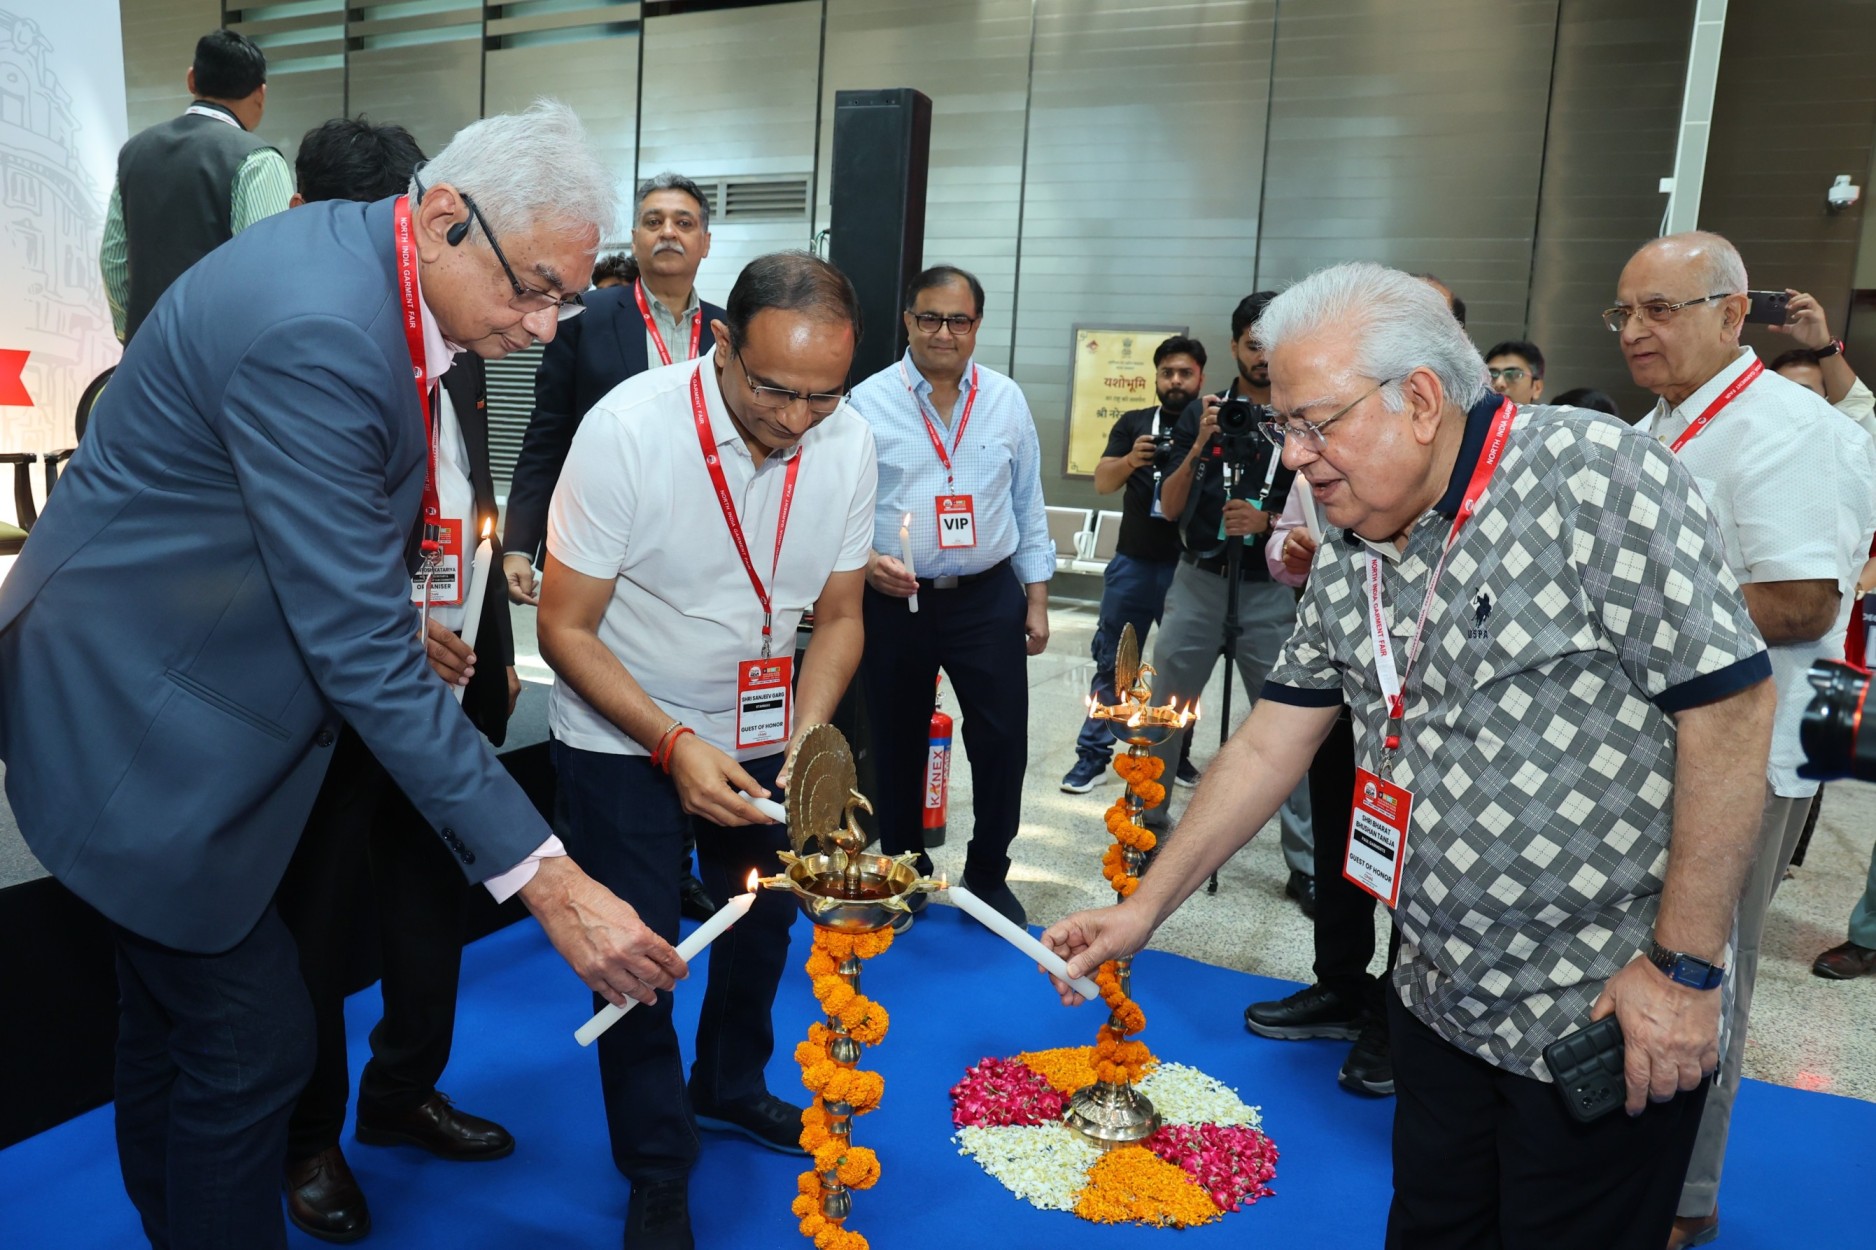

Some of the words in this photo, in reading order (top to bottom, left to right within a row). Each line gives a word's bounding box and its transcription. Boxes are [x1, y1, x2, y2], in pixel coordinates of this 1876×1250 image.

[400, 217, 409, 243] NORTH
[401, 246, 410, 268] INDIA
[403, 270, 414, 309] GARMENT
[408, 311, 416, 329] FAIR
[693, 380, 702, 408] GARMENT
[1104, 375, 1146, 393] यशोभूमि
[697, 411, 705, 424] FAIR
[1486, 439, 1501, 465] NORTH
[1496, 420, 1508, 438] INDIA
[720, 490, 730, 510] NORTH
[728, 512, 736, 527] INDIA
[734, 528, 747, 556] GARMENT
[781, 499, 789, 528] GARMENT
[944, 518, 969, 530] VIP
[1373, 603, 1384, 638] GARMENT
[1467, 629, 1489, 639] USPA
[1378, 639, 1388, 657] FAIR
[753, 693, 771, 701] SANJEEV
[772, 691, 784, 699] GARG
[765, 721, 784, 729] HONOR
[930, 750, 943, 806] KANEX
[1356, 820, 1377, 838] BHUSHAN
[1377, 832, 1395, 848] TANEJA
[1362, 814, 1372, 825] SHRI
[1372, 819, 1391, 835] BHARAT
[1349, 852, 1365, 866] GUEST
[1365, 862, 1373, 870] OF
[1373, 867, 1392, 883] HONOR
